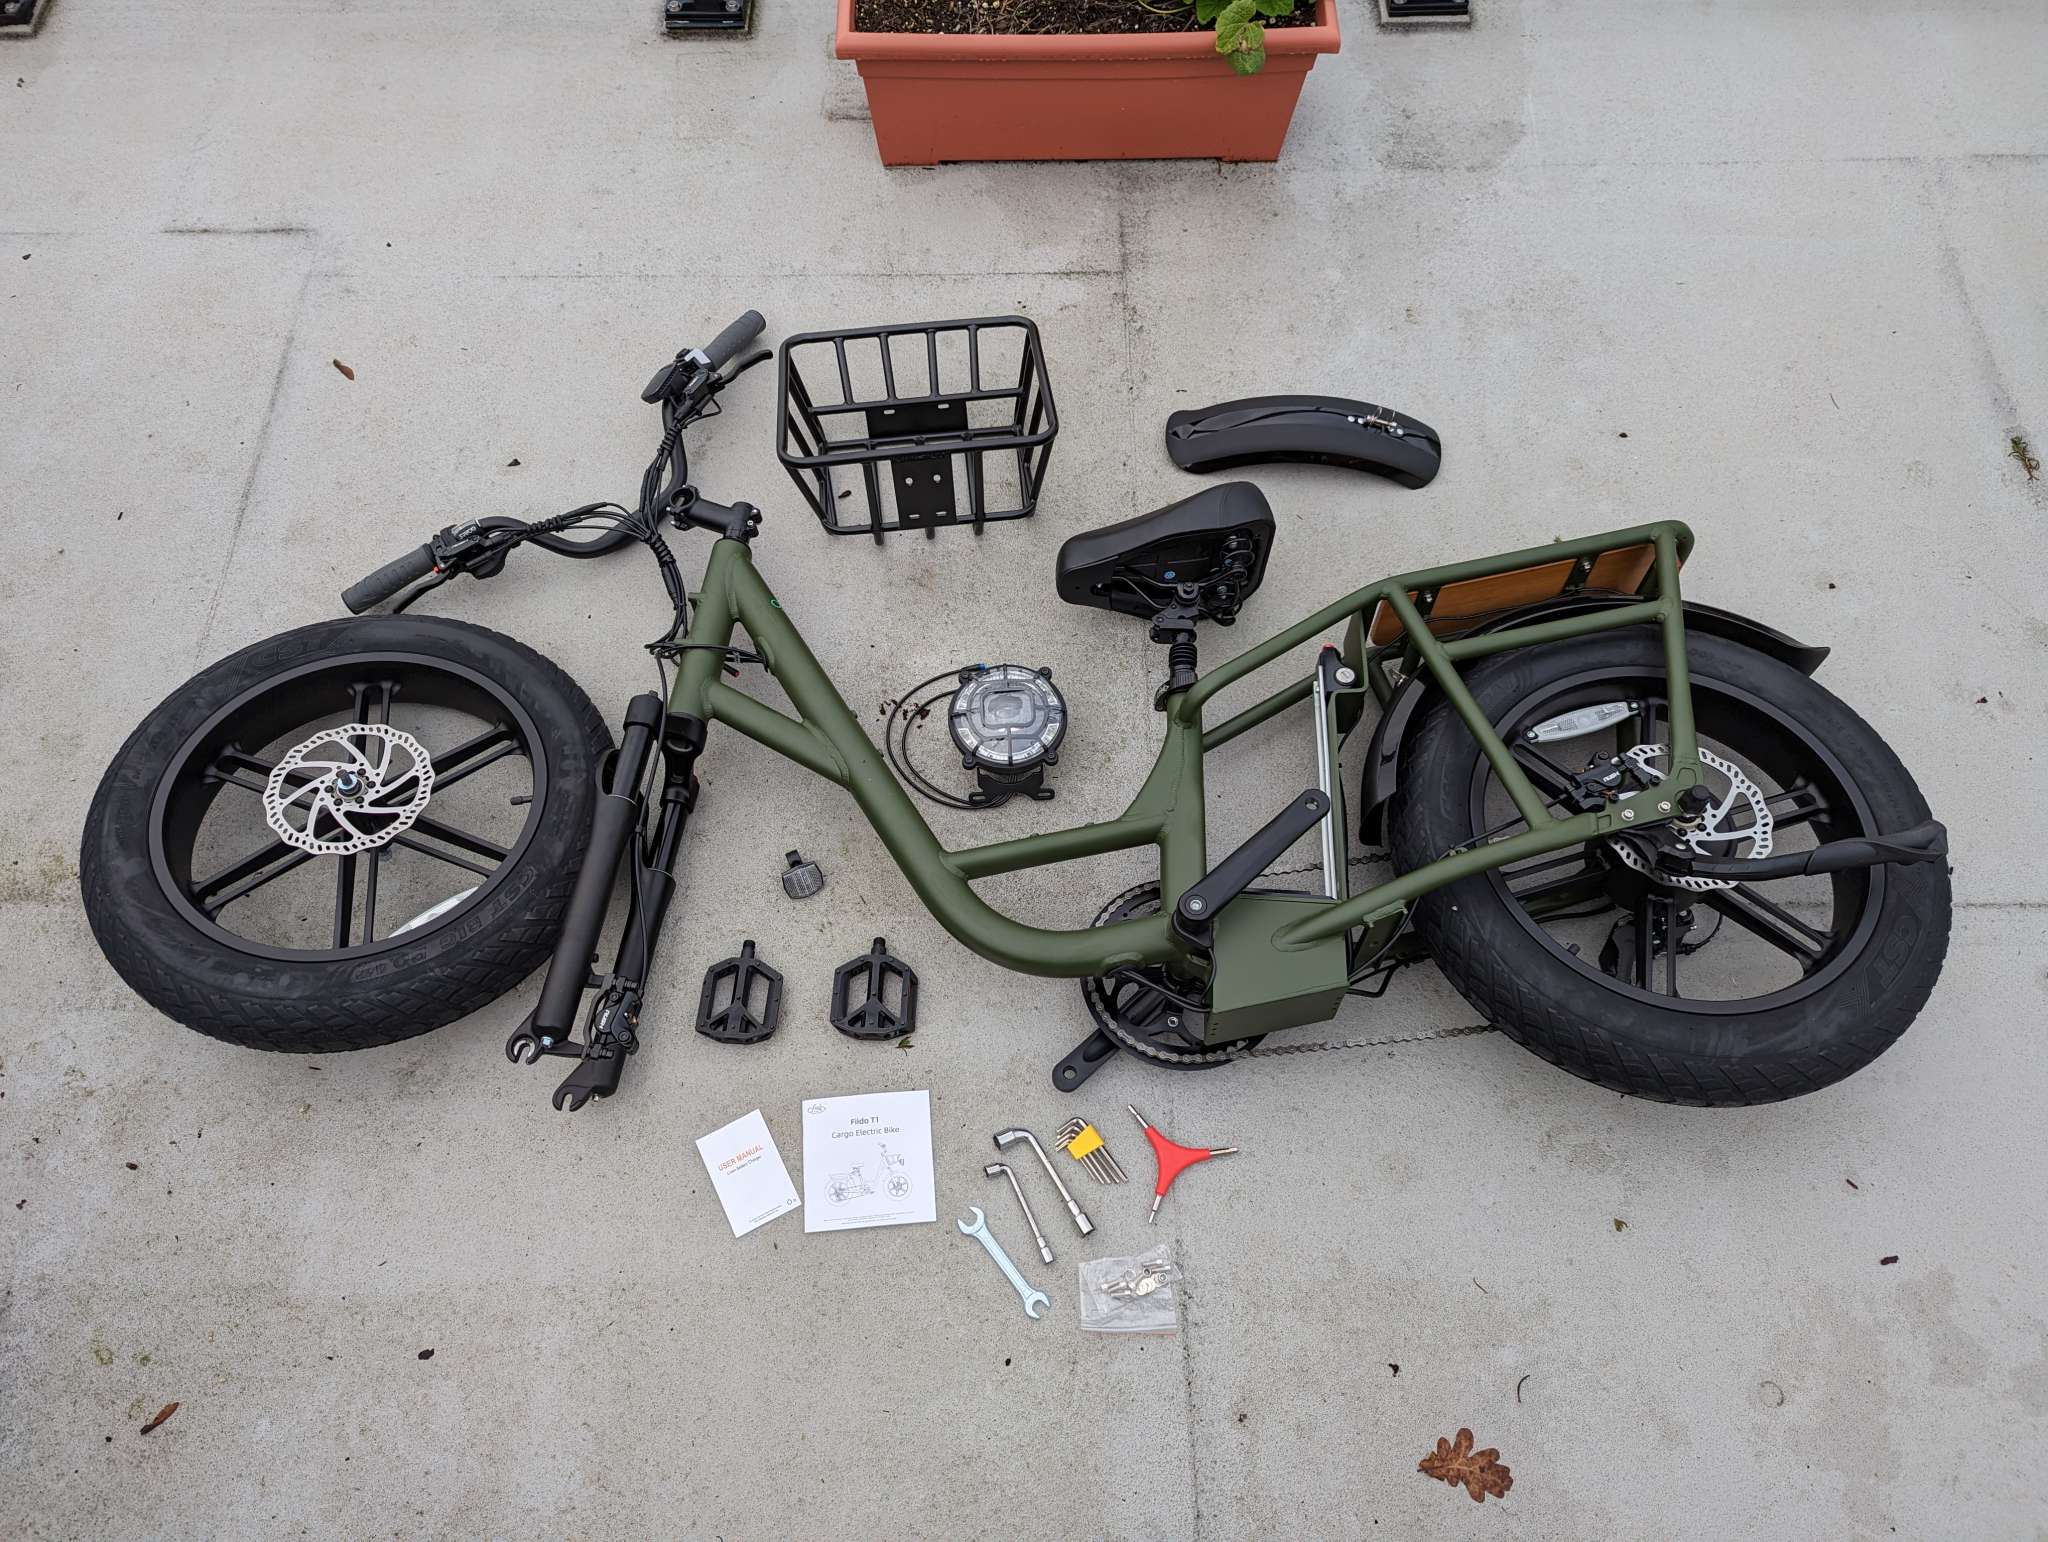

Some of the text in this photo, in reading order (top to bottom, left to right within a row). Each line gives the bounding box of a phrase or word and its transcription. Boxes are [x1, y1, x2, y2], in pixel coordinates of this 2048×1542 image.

[1873, 914, 1922, 989] CST
[850, 1116, 879, 1125] Fiido T1
[831, 1126, 900, 1139] Cargo Electric Bike
[718, 1145, 764, 1171] USER MANUAL
